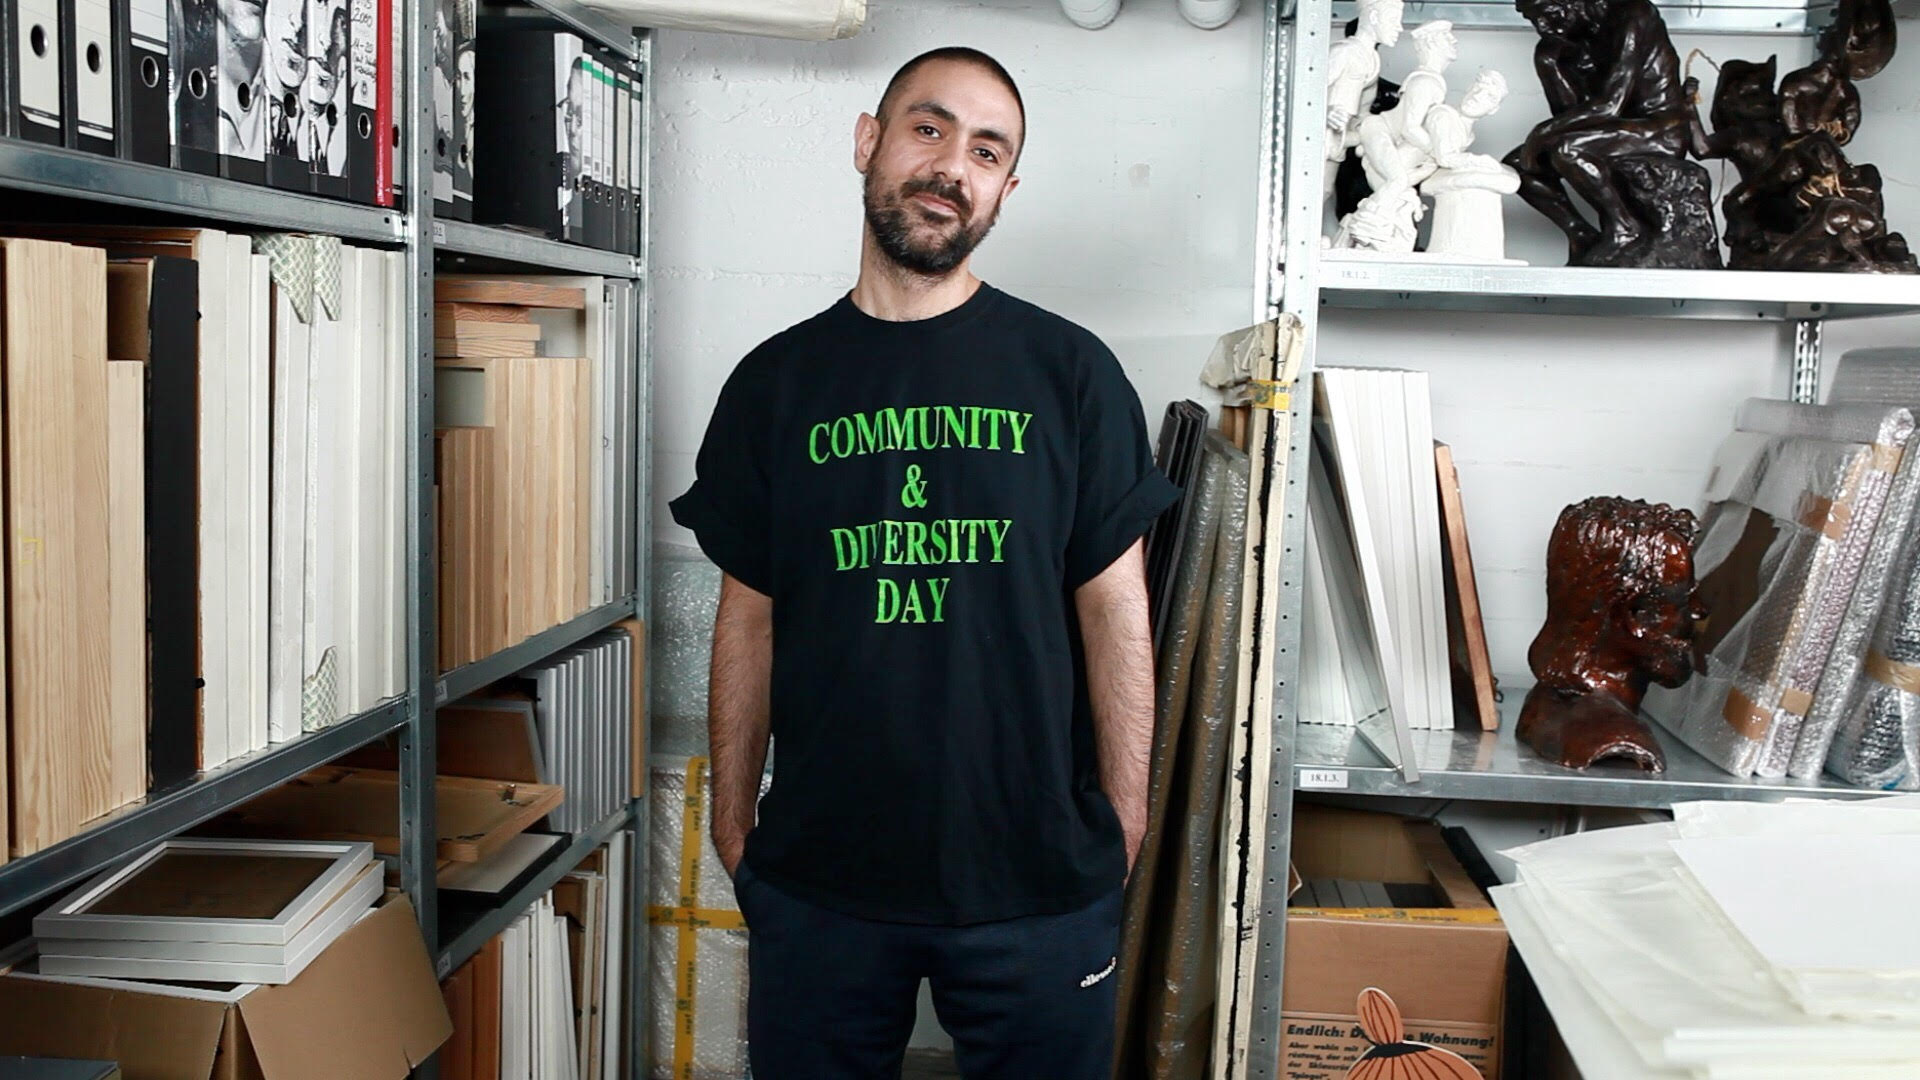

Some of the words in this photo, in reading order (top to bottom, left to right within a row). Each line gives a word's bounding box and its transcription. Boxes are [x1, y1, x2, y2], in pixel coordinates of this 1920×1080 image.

[809, 405, 1033, 464] COMMUNITY
[901, 464, 928, 508] &
[830, 519, 1012, 571] DIVERSITY
[874, 577, 950, 623] DAY
[1287, 1024, 1345, 1037] Endlich:
[1420, 1032, 1495, 1049] Wohnung!
